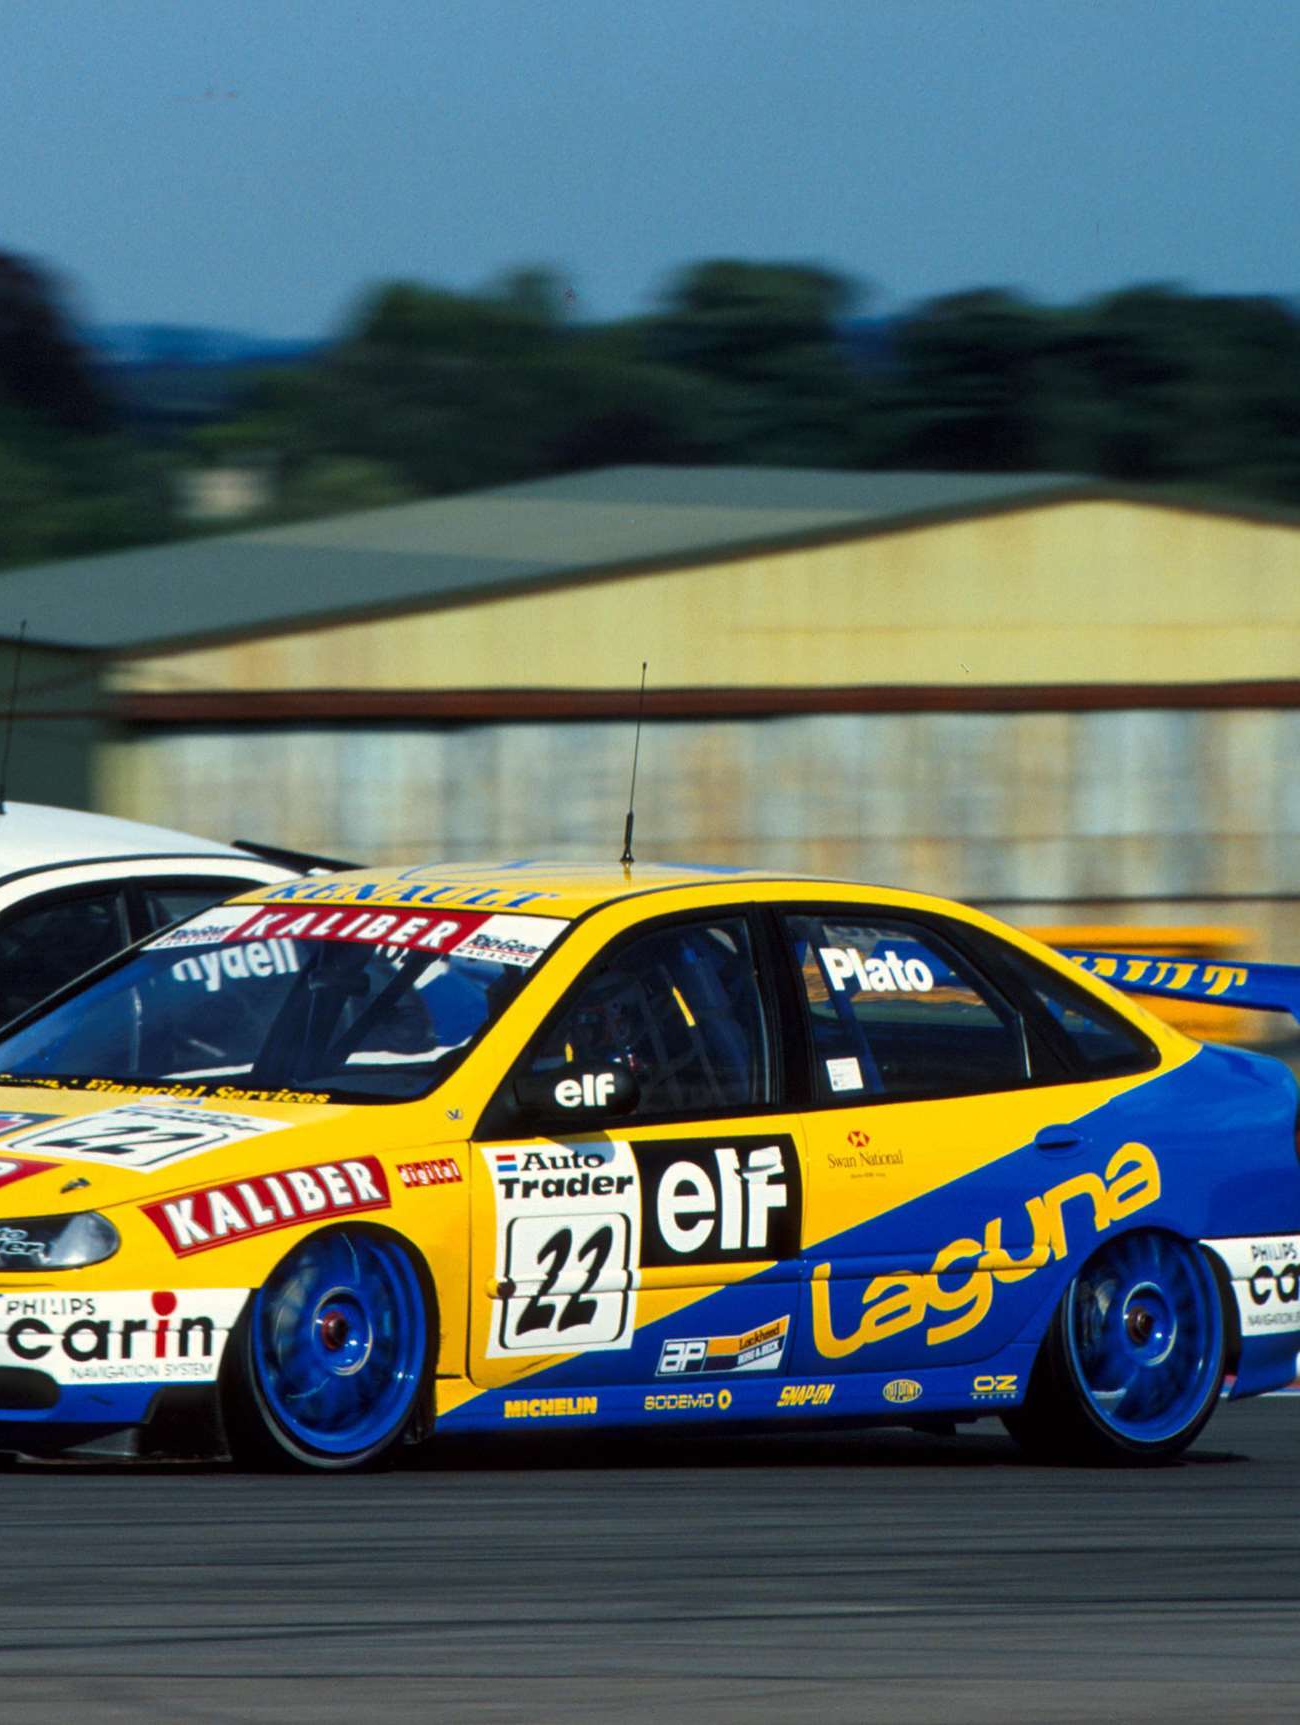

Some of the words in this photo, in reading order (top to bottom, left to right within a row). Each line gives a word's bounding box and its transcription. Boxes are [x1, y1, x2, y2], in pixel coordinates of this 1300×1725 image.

[265, 883, 560, 909] RENAULT
[241, 911, 460, 949] KALIBER
[818, 946, 935, 993] Plato
[86, 1079, 206, 1098] Financial
[207, 1086, 332, 1104] Services
[554, 1073, 615, 1108] elf
[33, 1125, 205, 1156] 22
[520, 1151, 605, 1171] Auto
[826, 1152, 858, 1169] Swan
[858, 1149, 904, 1167] National
[399, 1160, 461, 1186] digital
[498, 1174, 635, 1201] Trader
[657, 1145, 788, 1253] elf
[161, 1156, 383, 1249] KALIBER
[810, 1141, 1161, 1359] Laguna
[1251, 1241, 1299, 1261] PHILIPS
[515, 1224, 614, 1337] 22
[1249, 1263, 1300, 1306] ca
[5, 1297, 97, 1316] PHILIPS
[6, 1291, 215, 1362] carin
[69, 1363, 160, 1380] NAVIGATION
[164, 1361, 214, 1377] SYSTEM
[503, 1396, 598, 1419] MICHELIN
[644, 1392, 715, 1412] SODEMO
